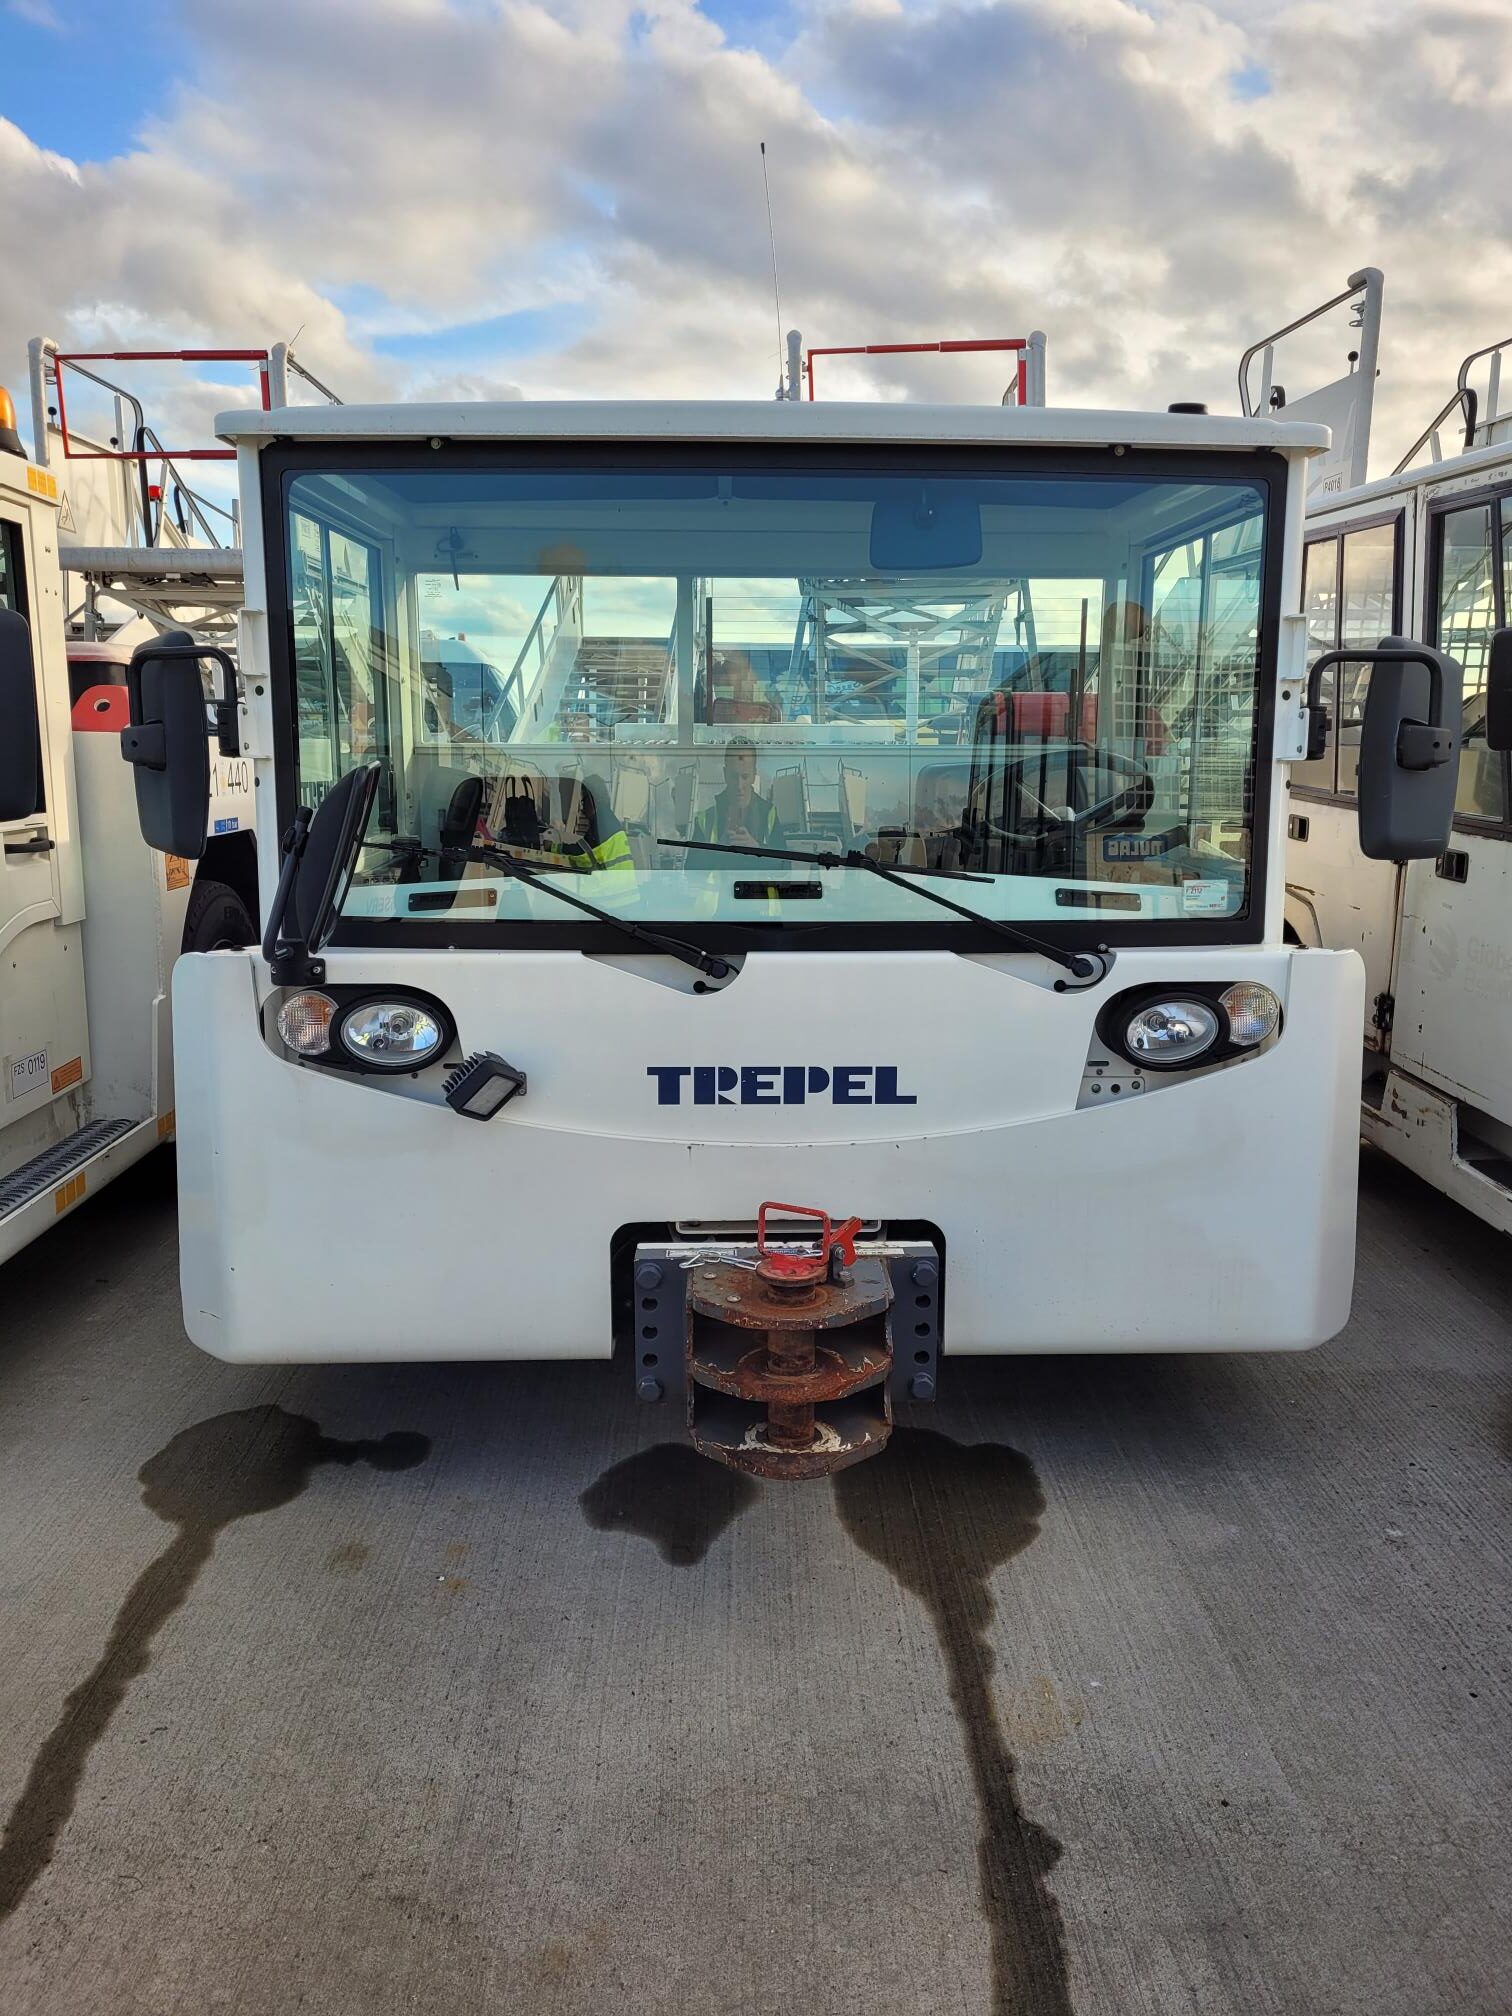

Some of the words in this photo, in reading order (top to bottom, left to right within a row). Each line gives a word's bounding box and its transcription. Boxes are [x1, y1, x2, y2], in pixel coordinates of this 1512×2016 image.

[228, 761, 249, 795] 440
[13, 1062, 25, 1076] FZS
[27, 1053, 46, 1075] 0119
[647, 1066, 917, 1105] TREPEL
